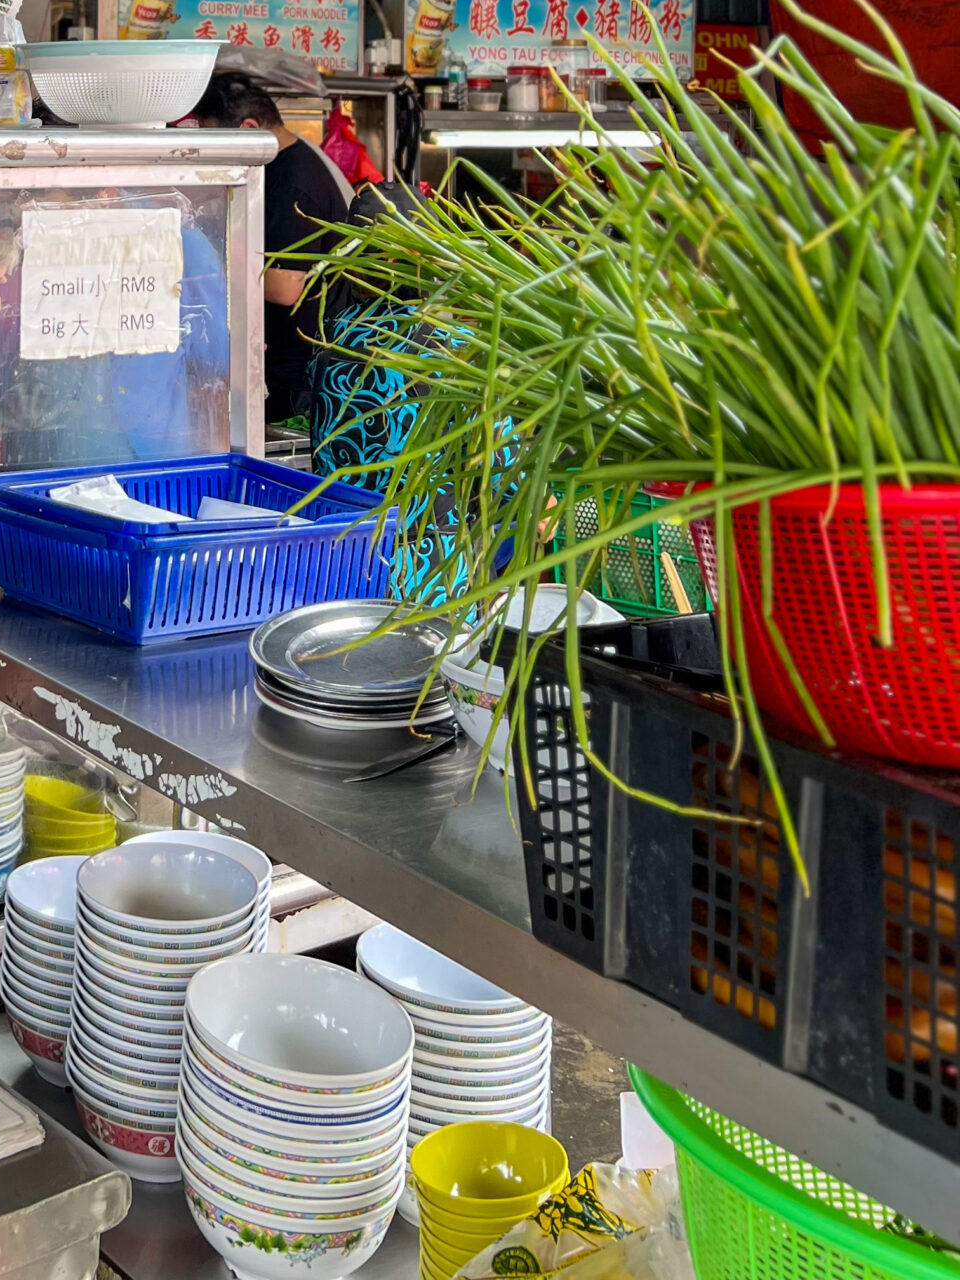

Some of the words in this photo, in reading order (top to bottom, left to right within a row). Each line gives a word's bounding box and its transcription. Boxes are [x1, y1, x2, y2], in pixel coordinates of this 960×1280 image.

[199, 2, 240, 17] CURRY
[243, 4, 268, 17] MEE
[283, 7, 308, 20] PORK
[311, 8, 348, 21] NOODLE
[469, 47, 508, 61] YONG
[512, 47, 537, 61] TAU
[670, 53, 688, 65] FUN
[41, 277, 84, 297] Small
[120, 276, 156, 293] RM8
[41, 317, 65, 338] Big
[72, 313, 89, 337] 大
[120, 314, 155, 331] RM9
